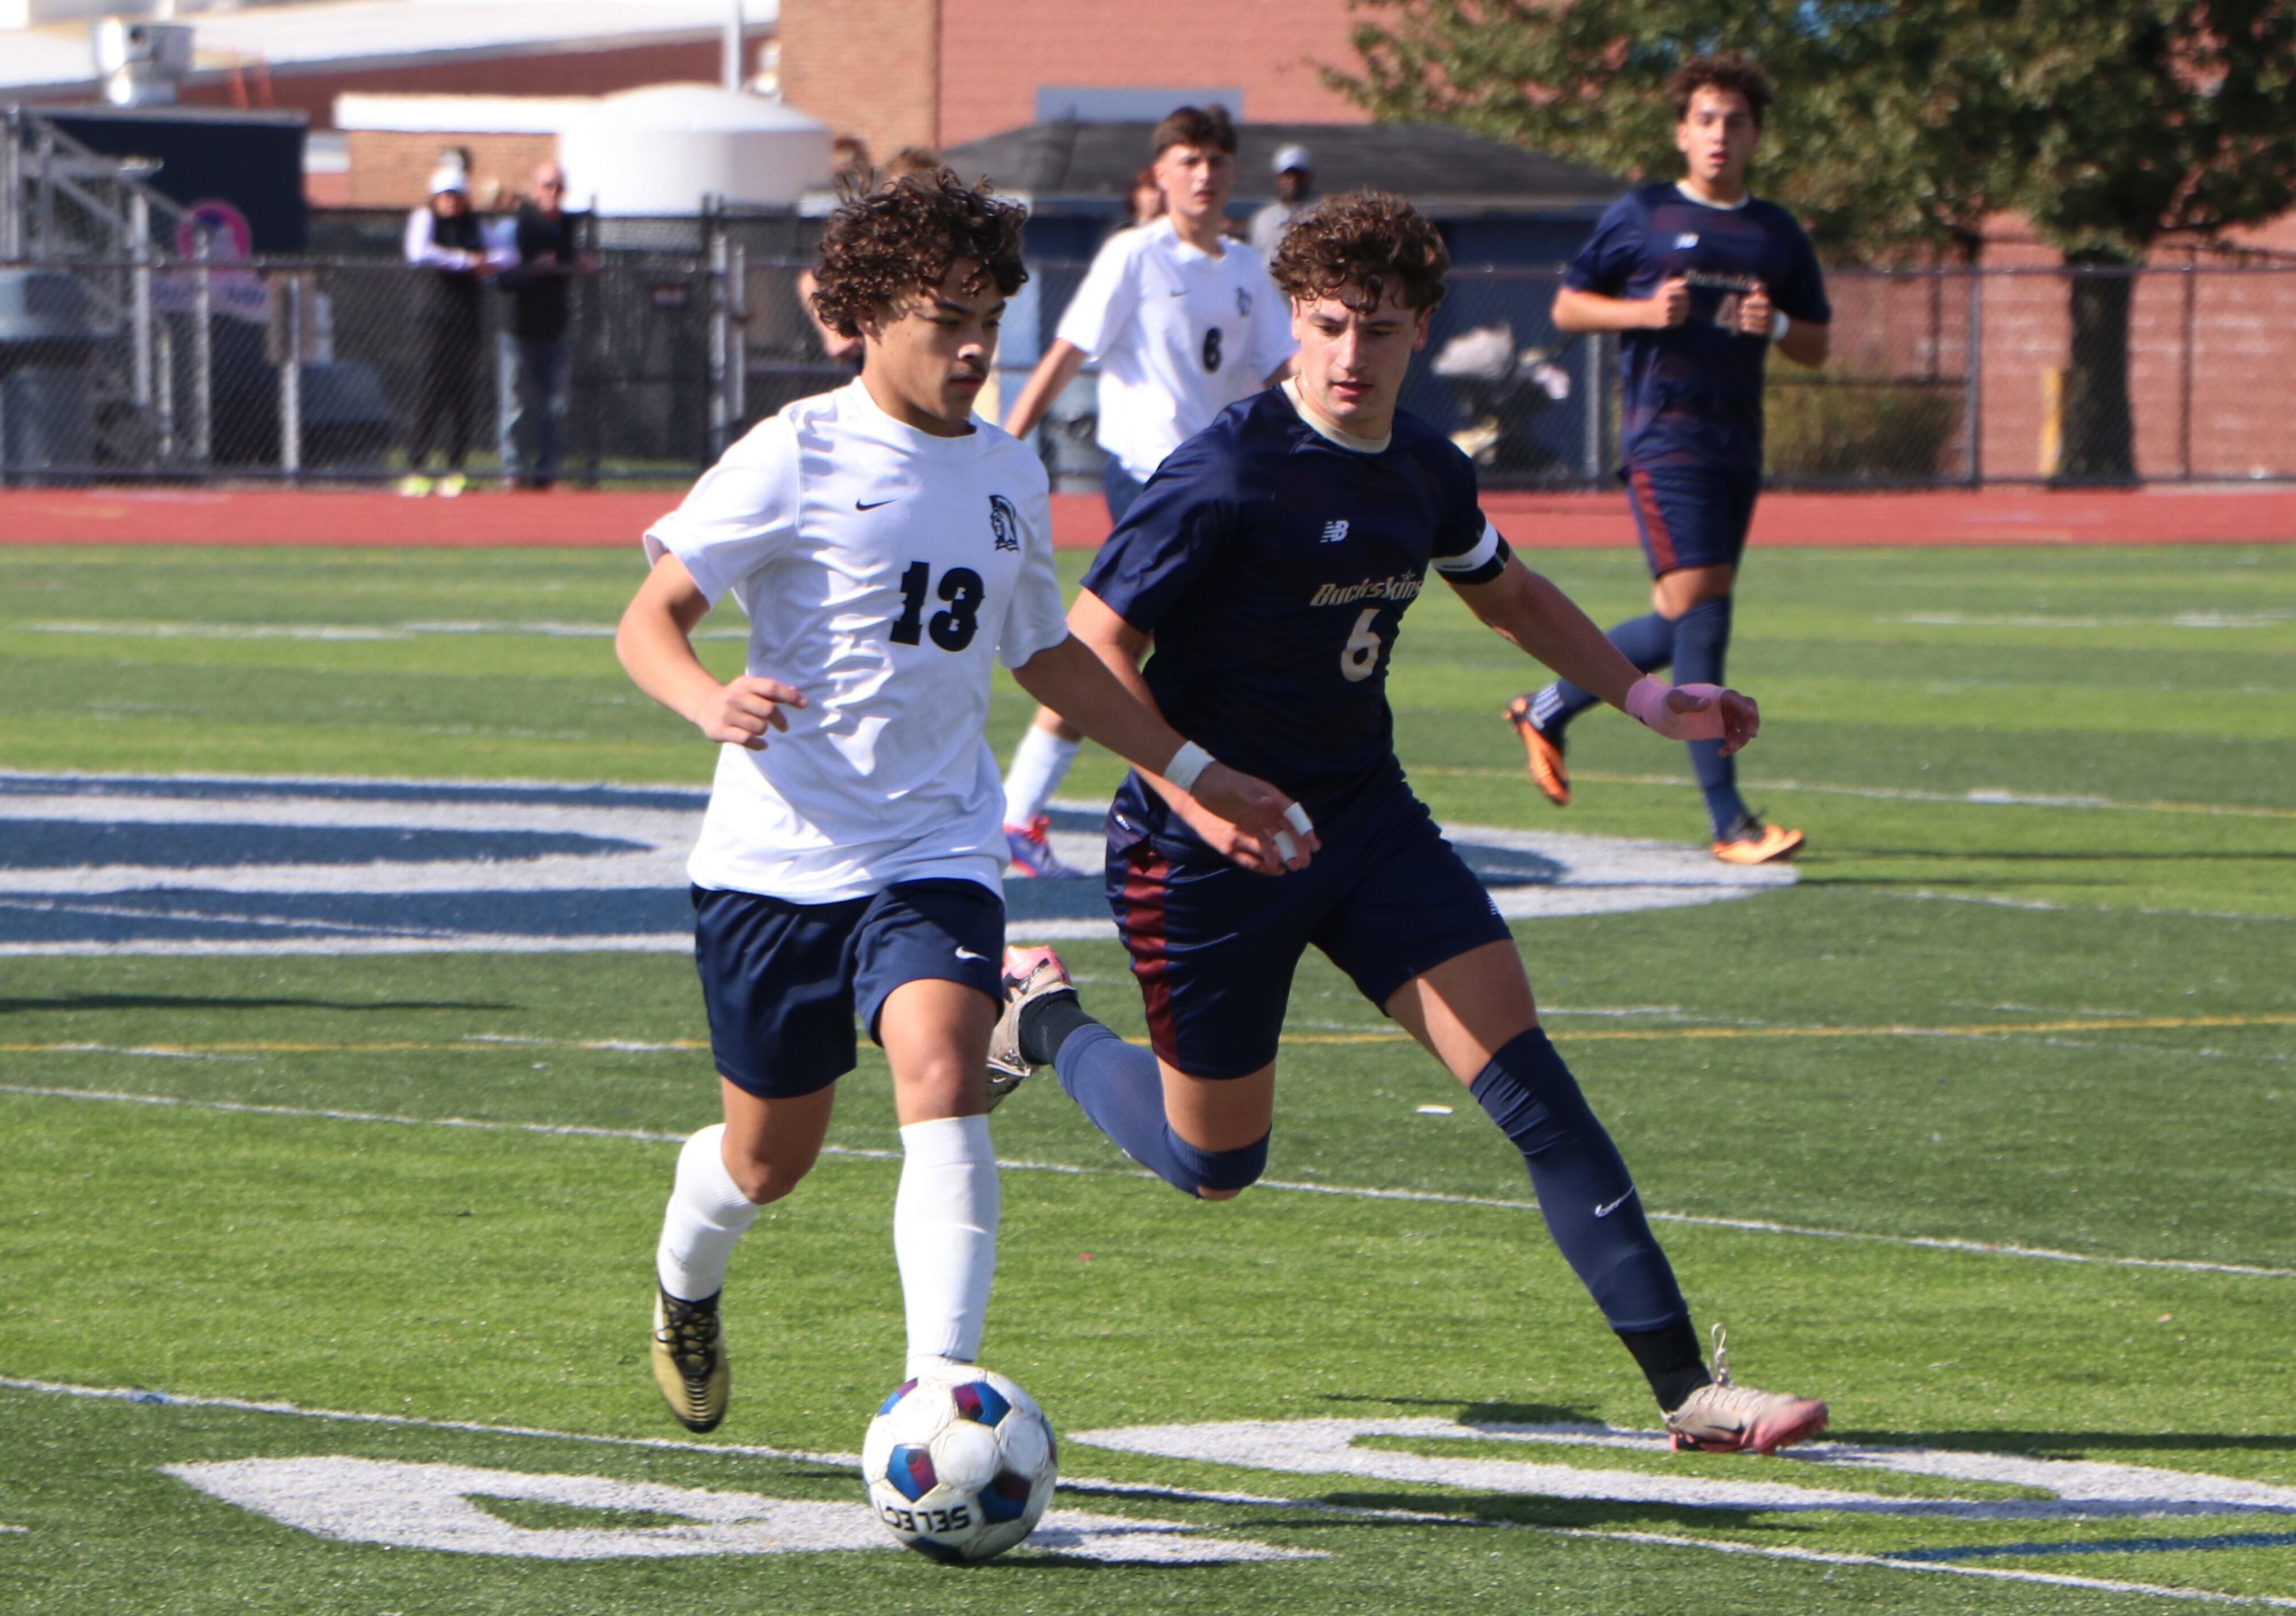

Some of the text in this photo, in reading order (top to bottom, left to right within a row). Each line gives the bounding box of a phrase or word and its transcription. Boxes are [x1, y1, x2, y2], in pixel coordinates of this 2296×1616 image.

[889, 560, 986, 652] 13
[1309, 576, 1424, 606] Buckskins
[1340, 608, 1381, 682] 6
